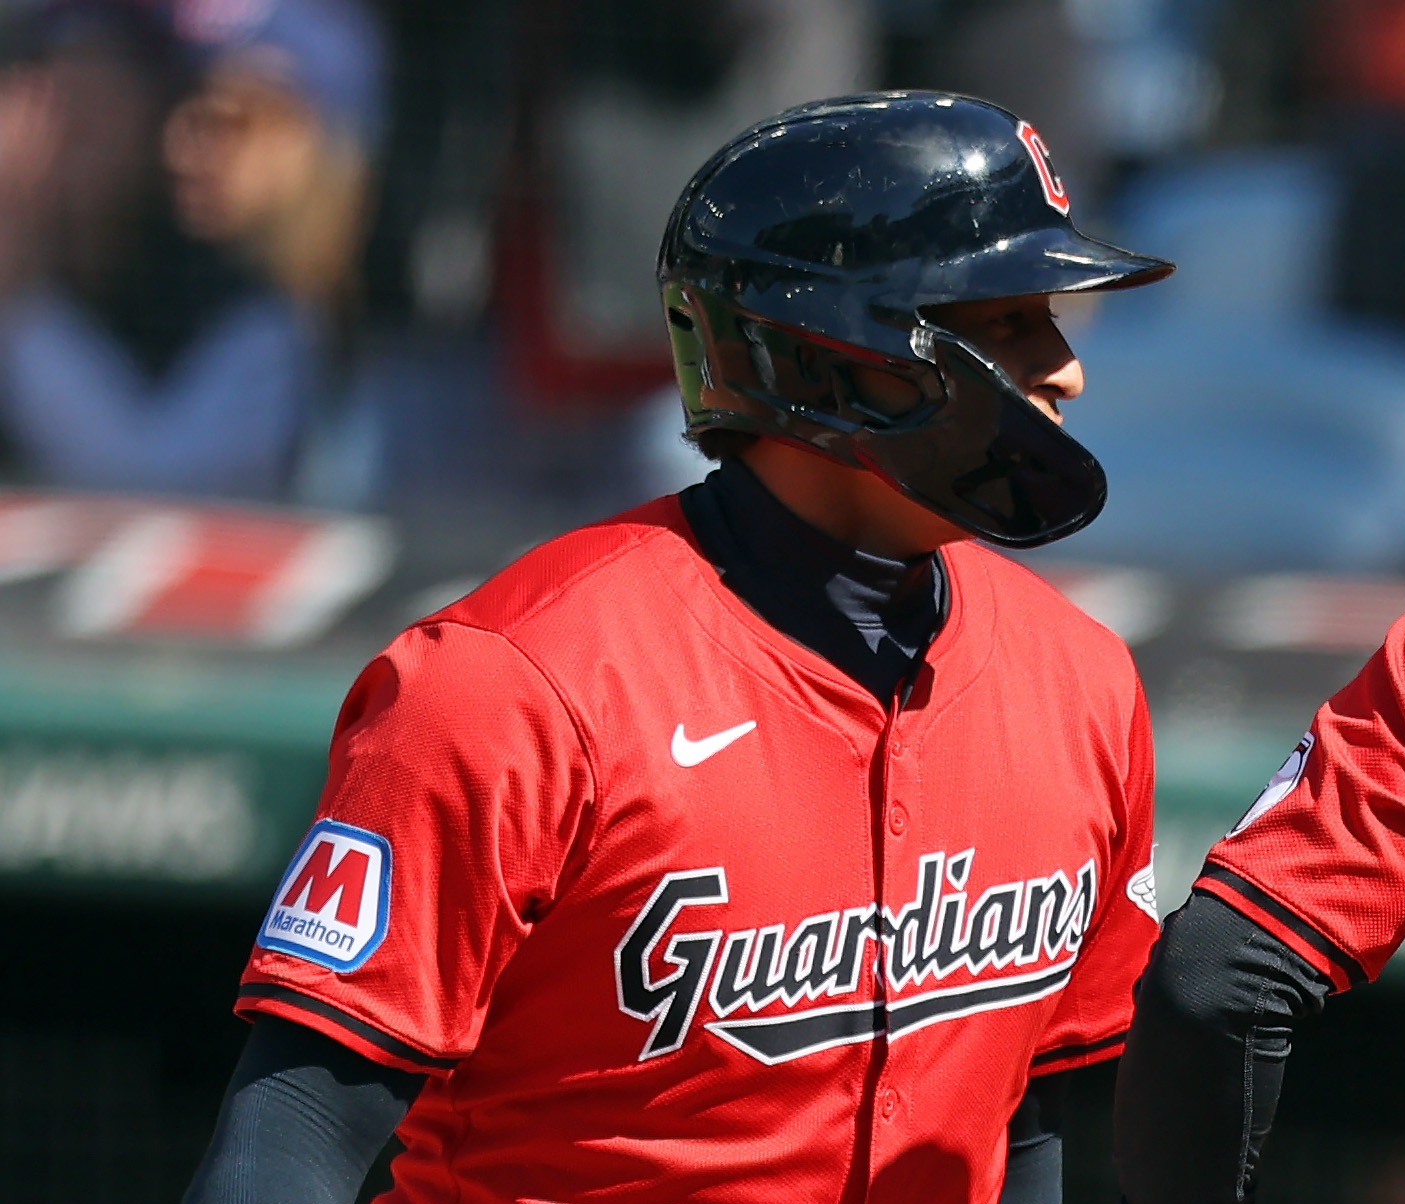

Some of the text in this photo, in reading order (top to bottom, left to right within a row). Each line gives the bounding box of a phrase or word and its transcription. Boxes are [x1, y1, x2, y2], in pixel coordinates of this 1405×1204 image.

[279, 840, 371, 929] M
[268, 909, 356, 952] Marathon
[613, 847, 1099, 1066] Guardians
